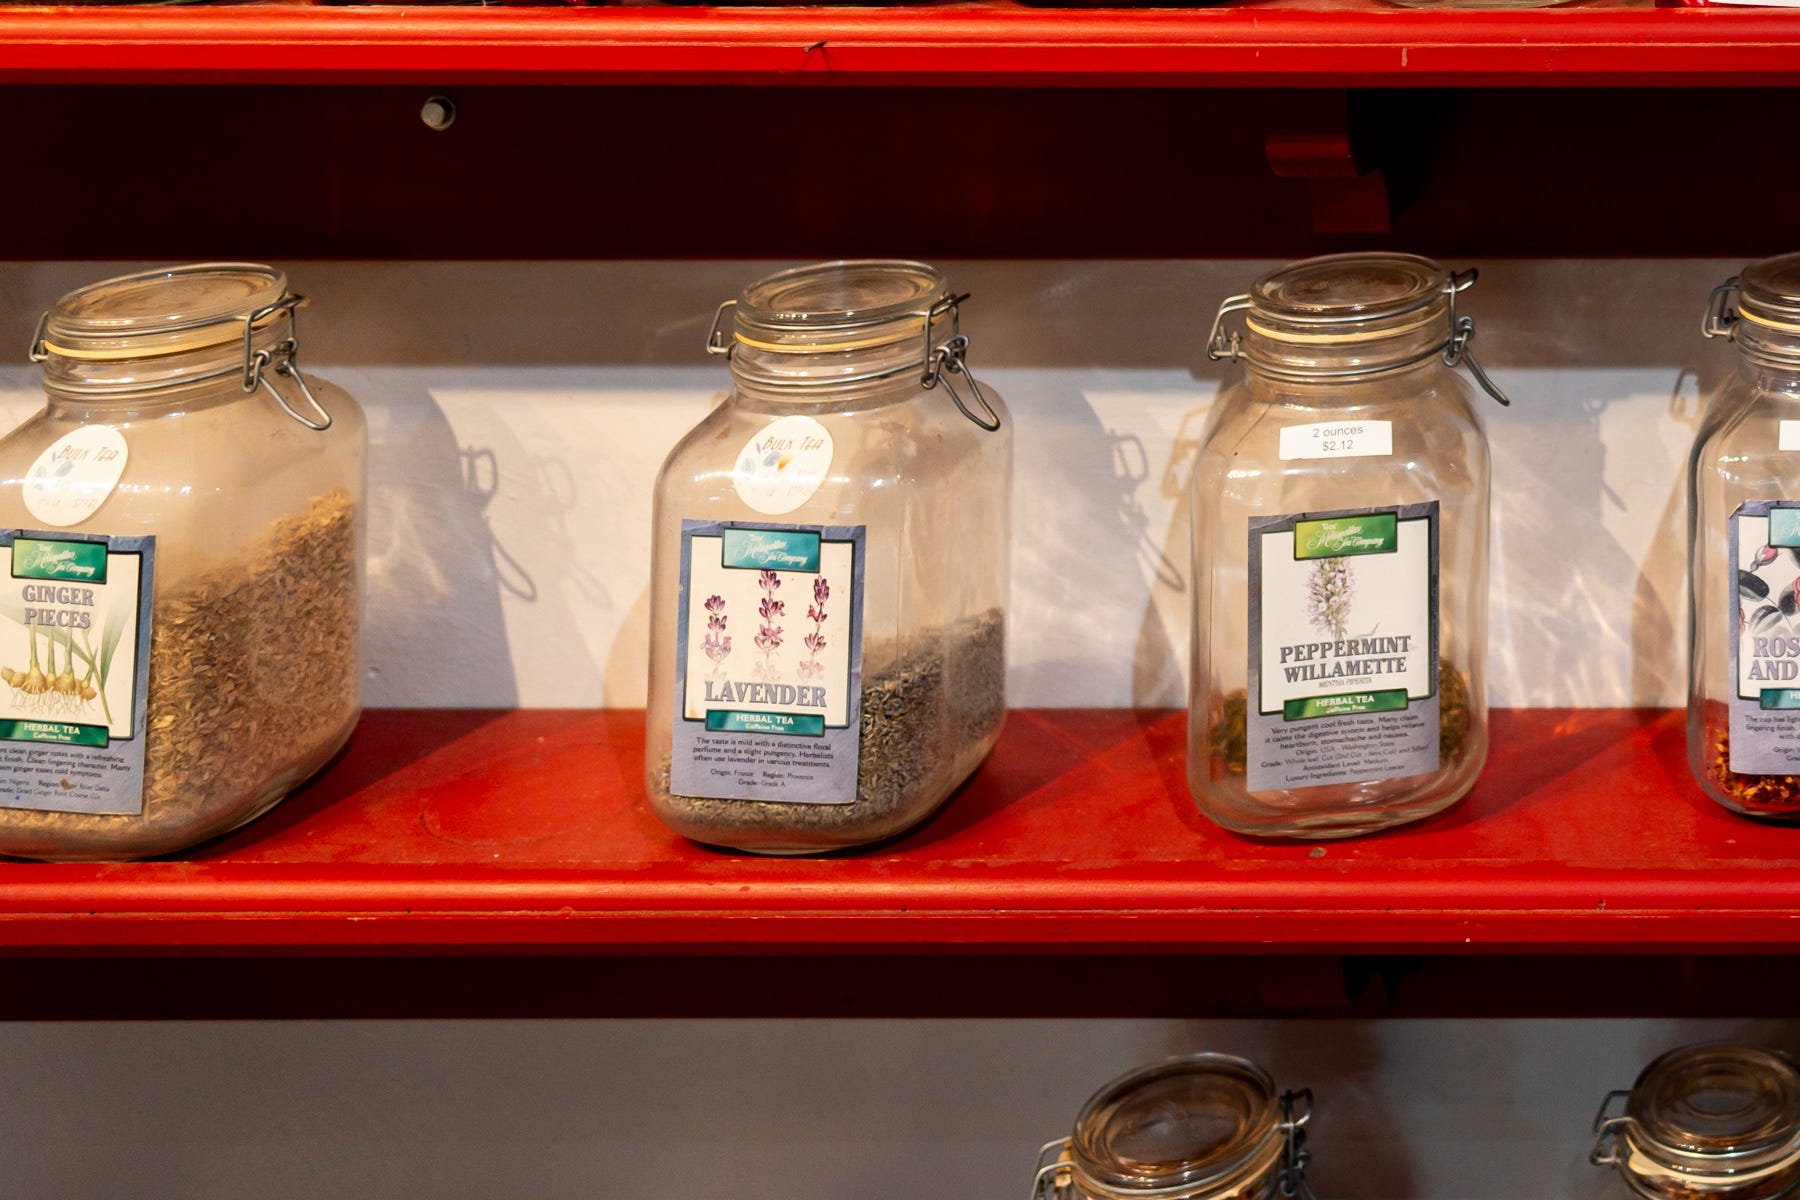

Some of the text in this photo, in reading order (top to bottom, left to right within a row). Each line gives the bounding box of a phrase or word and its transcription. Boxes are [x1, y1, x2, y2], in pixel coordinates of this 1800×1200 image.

[1312, 425, 1363, 437] 2 ounces
[1322, 439, 1353, 452] $2.12
[22, 585, 94, 607] GINGER
[24, 608, 91, 630] PIECES
[1280, 635, 1411, 664] PEPPERMINT
[1283, 657, 1407, 683] WILLAMETTE
[1747, 660, 1798, 680] AND
[705, 681, 827, 708] LAVENDER
[736, 713, 773, 723] HERBAL
